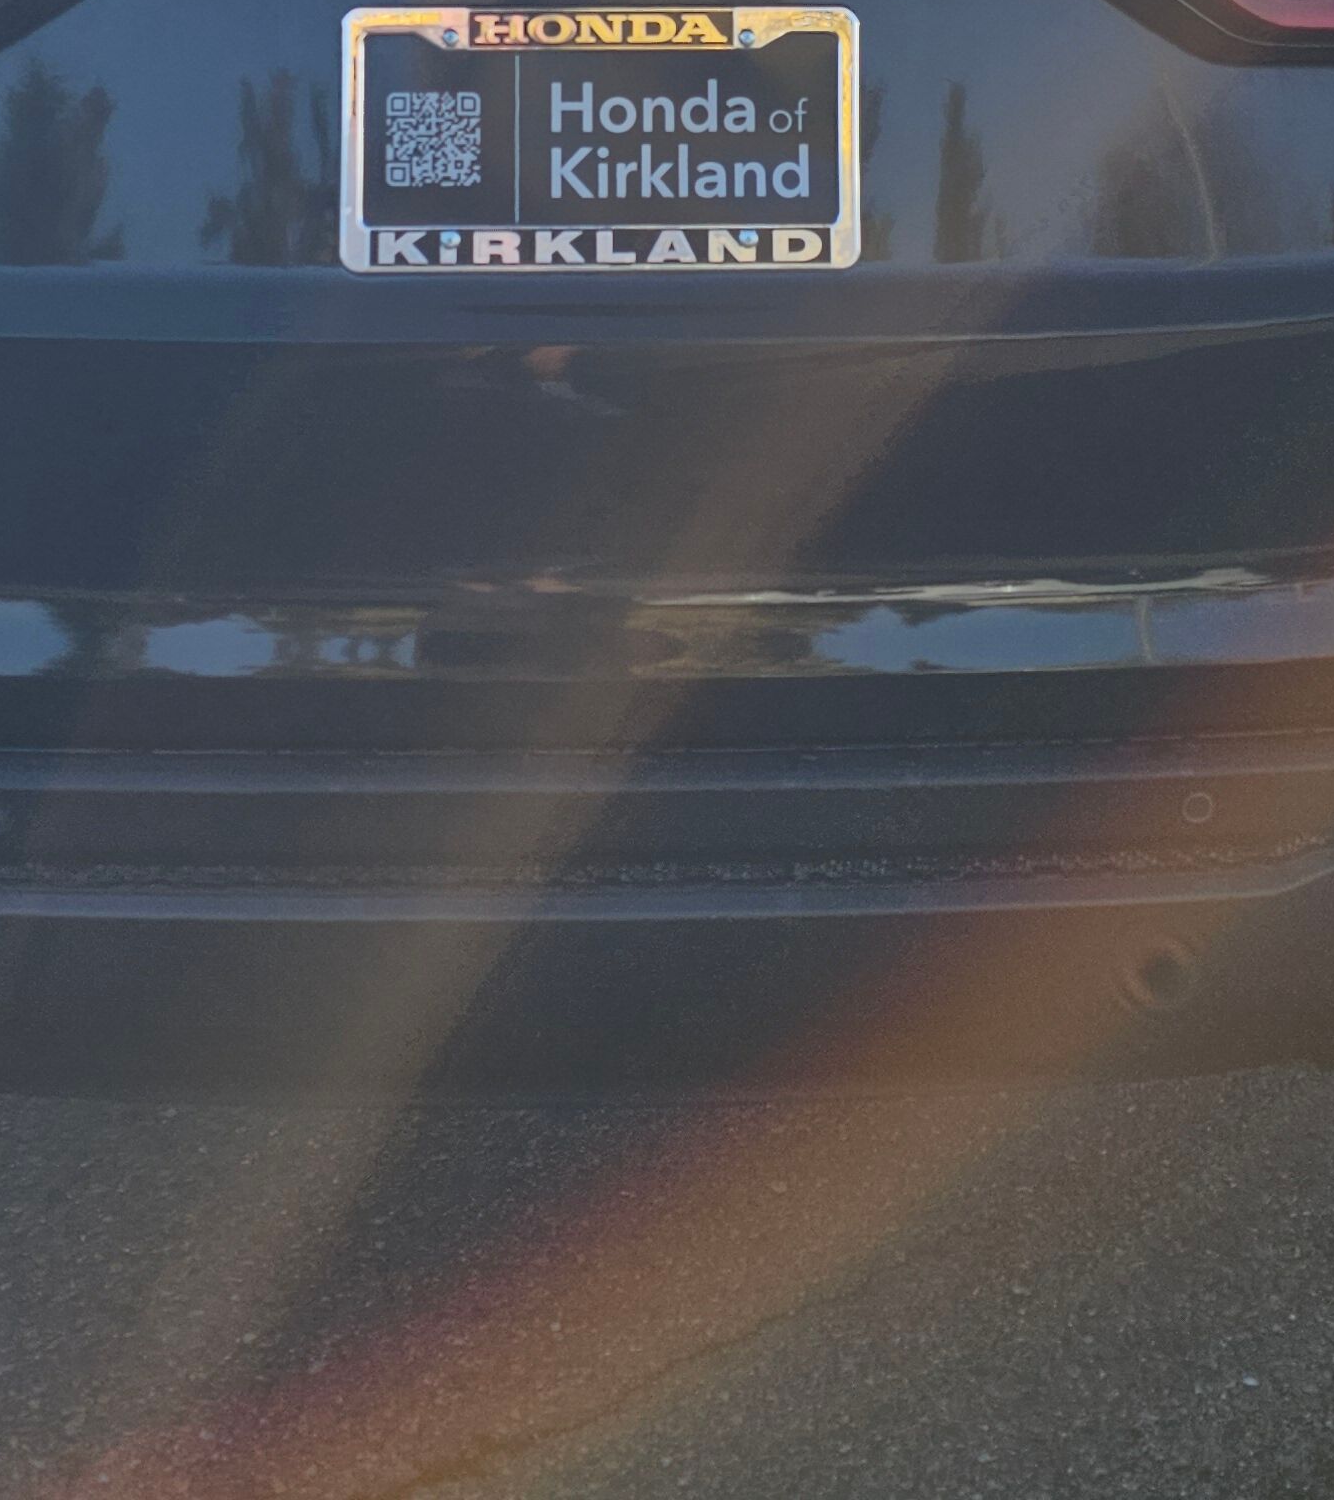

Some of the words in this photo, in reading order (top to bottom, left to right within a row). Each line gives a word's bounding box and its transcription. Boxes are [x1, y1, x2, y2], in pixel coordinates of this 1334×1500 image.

[473, 13, 728, 45] HONDA
[550, 79, 756, 134] Honda
[768, 97, 808, 134] of
[550, 143, 811, 199] Kirkland
